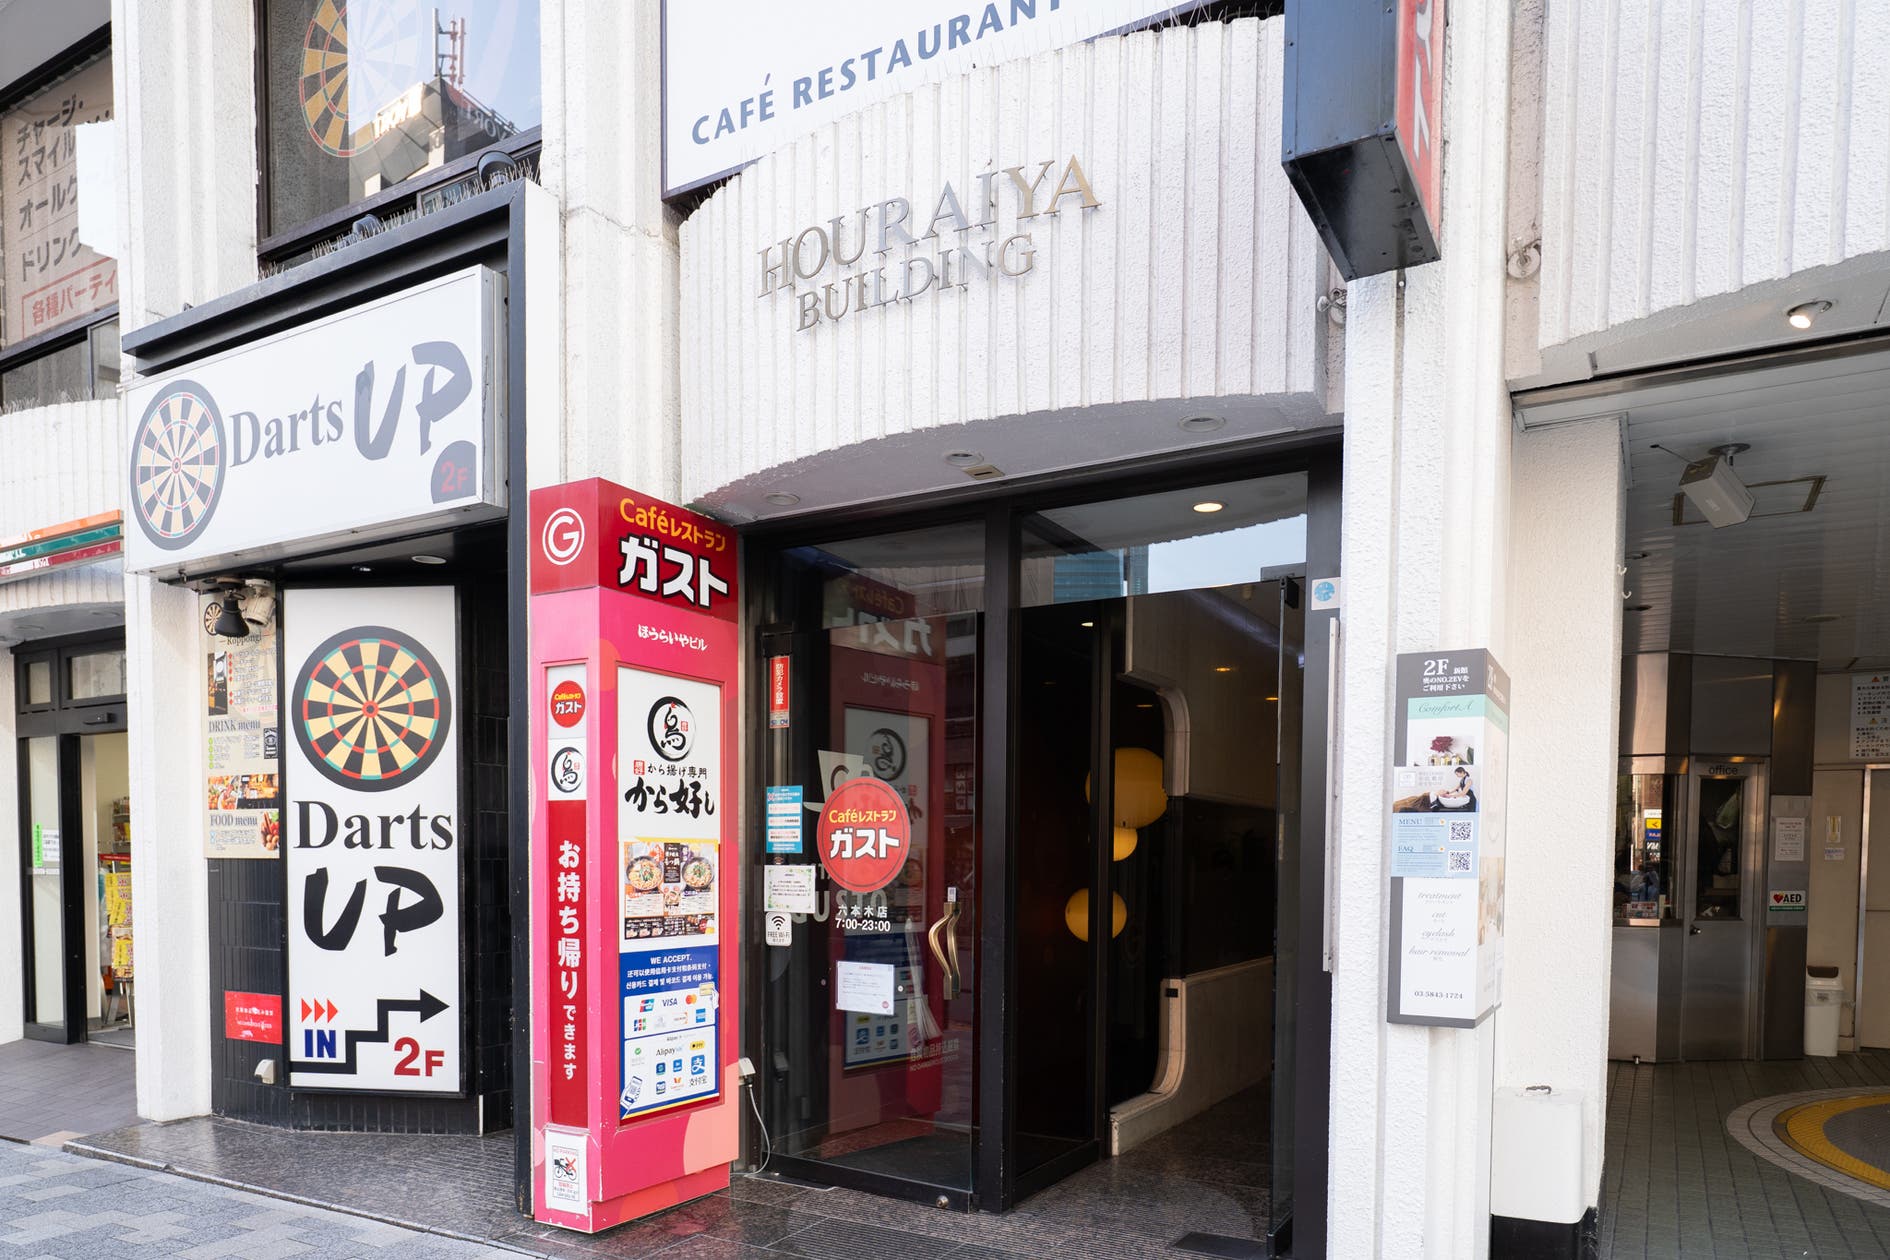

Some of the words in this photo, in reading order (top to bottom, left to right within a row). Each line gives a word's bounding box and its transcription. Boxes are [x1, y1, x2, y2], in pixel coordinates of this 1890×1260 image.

[692, 73, 776, 145] CAFÉ
[757, 154, 1102, 298] HOURAIYA
[797, 232, 1037, 332] BUILDING
[229, 393, 344, 468] Darts
[354, 340, 473, 461] UP
[440, 459, 469, 494] 2F
[619, 498, 726, 552] Caféレストラン
[618, 533, 729, 609] ガスト
[638, 624, 708, 651] ほうらいやビル
[1423, 658, 1449, 676] 2F
[555, 701, 582, 715] ガスト
[208, 720, 237, 733] DRINK
[647, 763, 708, 780] から揚げ専門
[1708, 764, 1739, 775] office
[624, 776, 715, 819] から好し
[210, 814, 234, 826] FOOD
[235, 815, 258, 826] menu
[293, 800, 453, 851] Darts
[829, 808, 897, 824] Caféレストラン
[829, 827, 900, 860] ガスト
[303, 866, 444, 957] UP
[837, 905, 888, 920] 六本木店
[1783, 893, 1802, 903] AED
[557, 840, 581, 1080] お持ち帰りできます
[650, 956, 661, 965] WE
[662, 998, 678, 1007] VISA
[304, 1029, 337, 1058] IN
[393, 1037, 445, 1077] 2F
